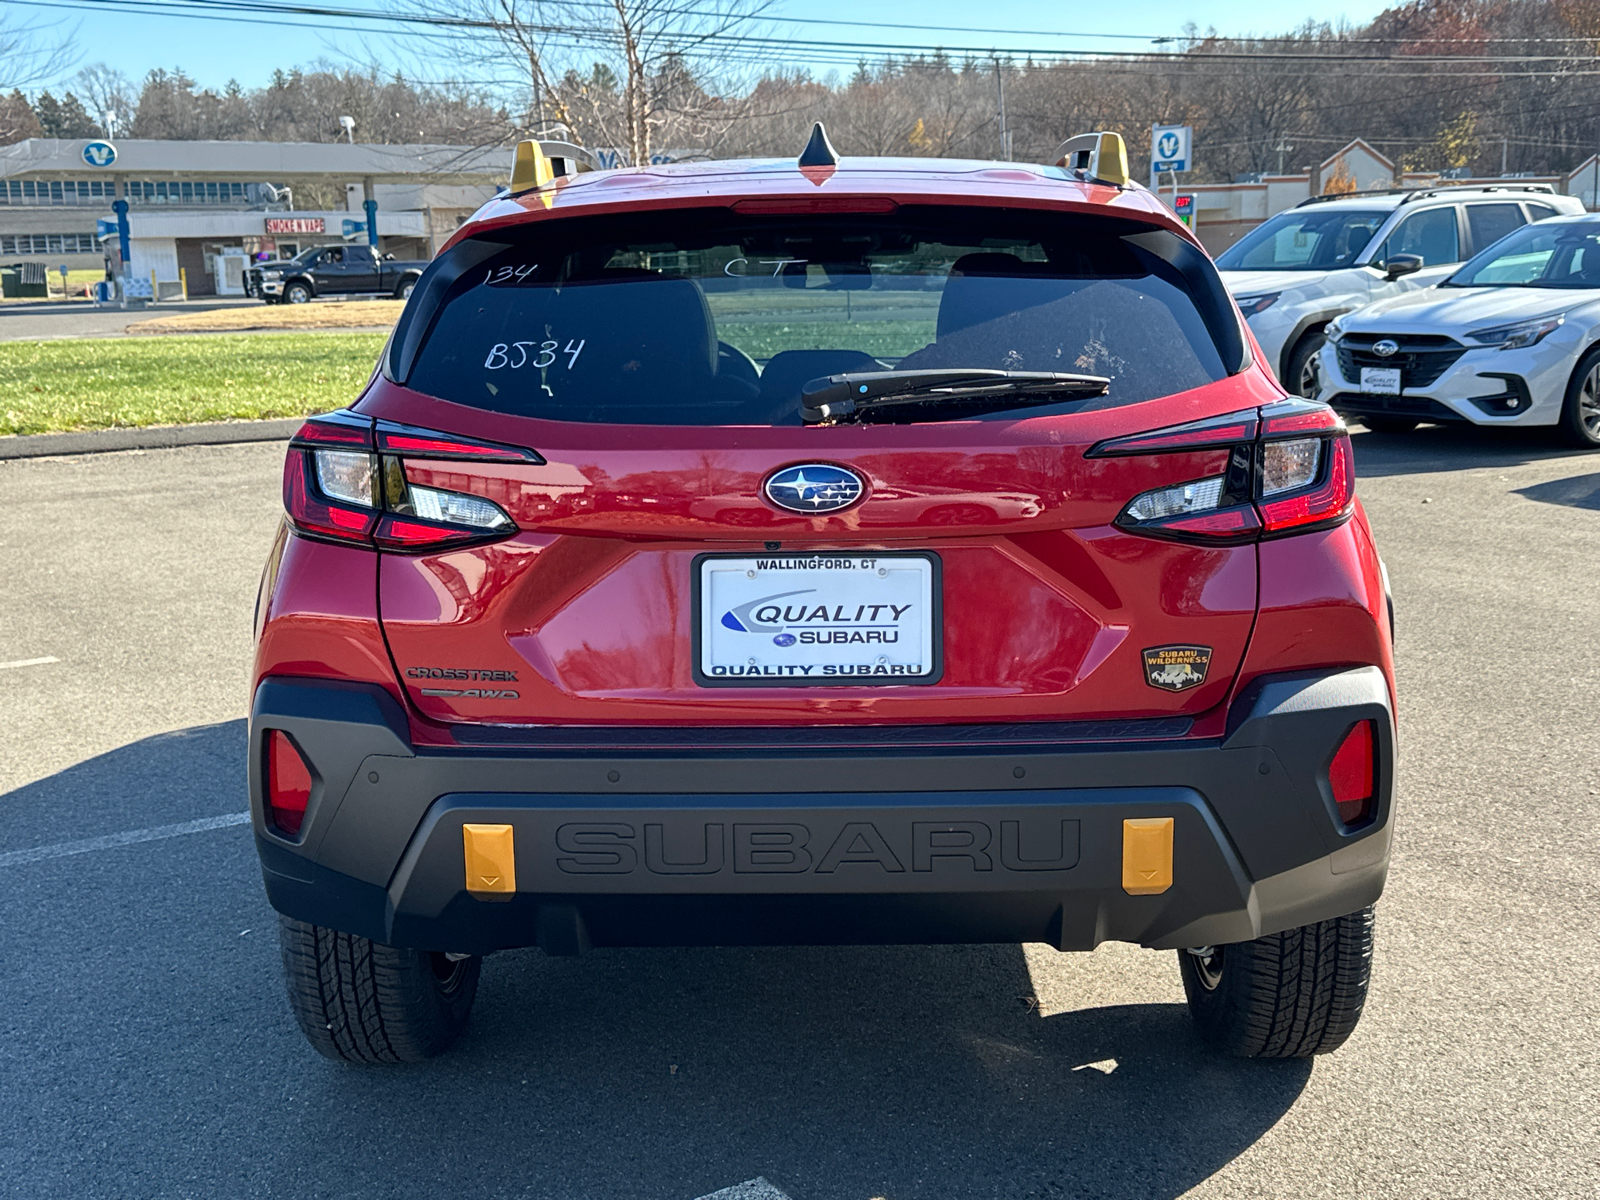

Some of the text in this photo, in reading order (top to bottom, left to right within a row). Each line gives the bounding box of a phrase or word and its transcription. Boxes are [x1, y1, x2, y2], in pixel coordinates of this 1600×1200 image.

[267, 219, 324, 234] SMOKE N VAPE
[756, 559, 877, 570] WALLINGFORD, CT
[755, 604, 913, 624] QUALITY
[799, 631, 899, 645] SUBARU
[1158, 650, 1198, 658] SUBARU
[1148, 656, 1208, 665] WILDERNESS
[404, 667, 519, 682] CROSSTREK
[711, 665, 923, 676] QUALITY SUBARU
[461, 689, 521, 699] AWD
[555, 819, 1082, 876] SUBARU
